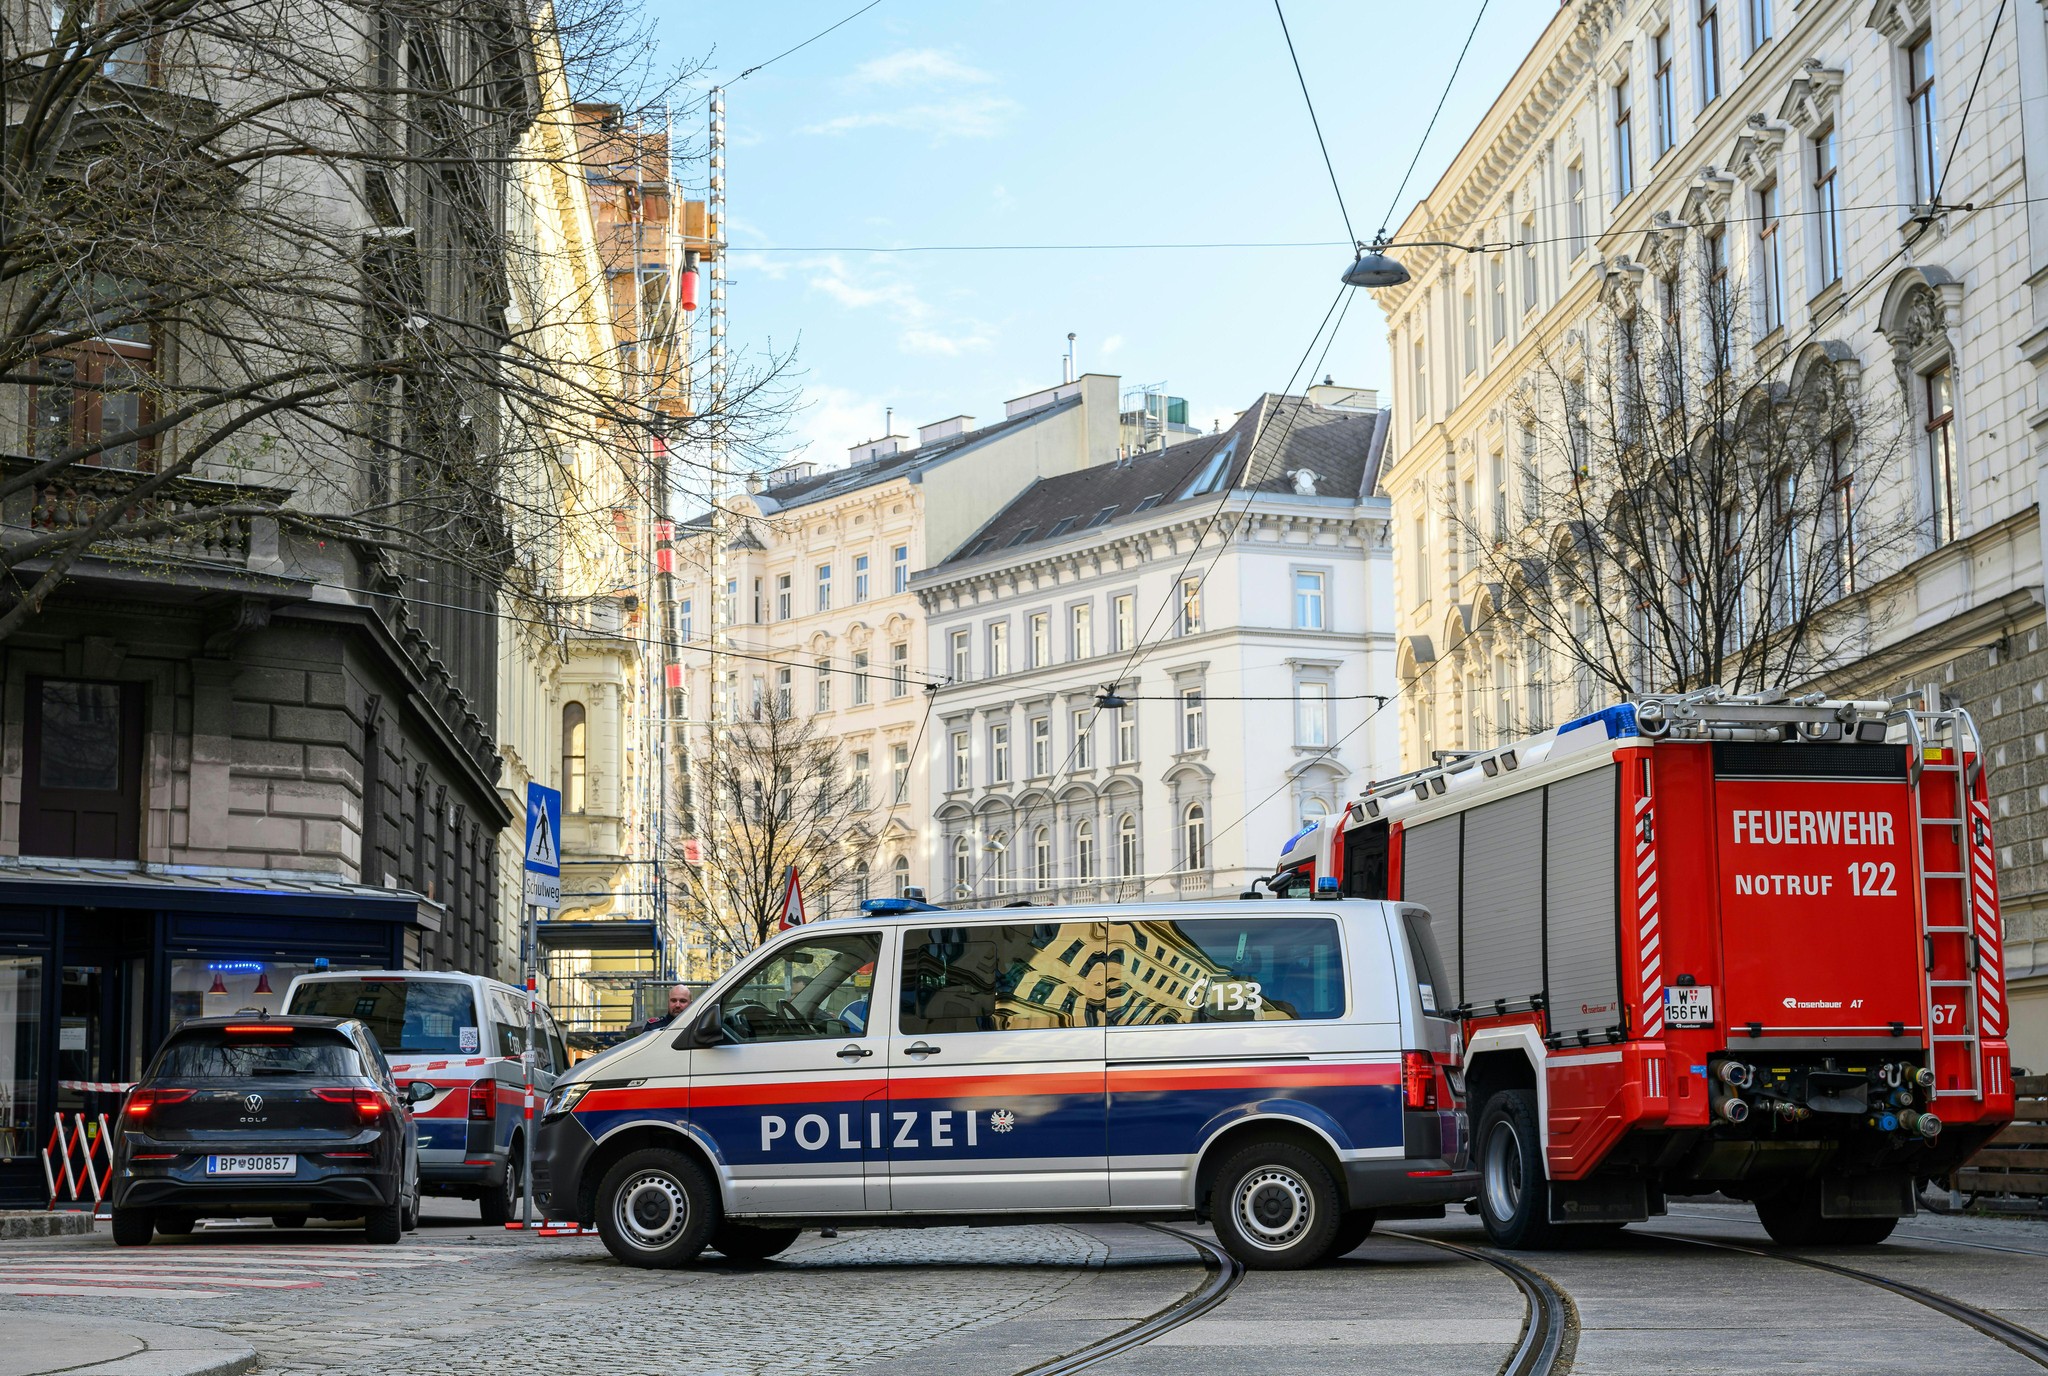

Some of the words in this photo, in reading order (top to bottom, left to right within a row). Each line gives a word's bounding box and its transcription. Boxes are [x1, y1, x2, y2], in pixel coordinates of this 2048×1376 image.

[1733, 810, 1895, 845] FEUERWEHR
[526, 878, 560, 903] Schulweg
[1735, 874, 1833, 896] NOTRUF
[1847, 861, 1898, 897] 122
[1211, 982, 1263, 1011] 133
[1678, 990, 1688, 1005] W
[1850, 999, 1864, 1009] AT
[1665, 1005, 1688, 1020] 156
[1690, 1005, 1708, 1020] FW
[1932, 1004, 1957, 1025] 67
[761, 1110, 978, 1151] POLIZEI
[220, 1158, 237, 1171] BP
[247, 1157, 290, 1171] 90857
